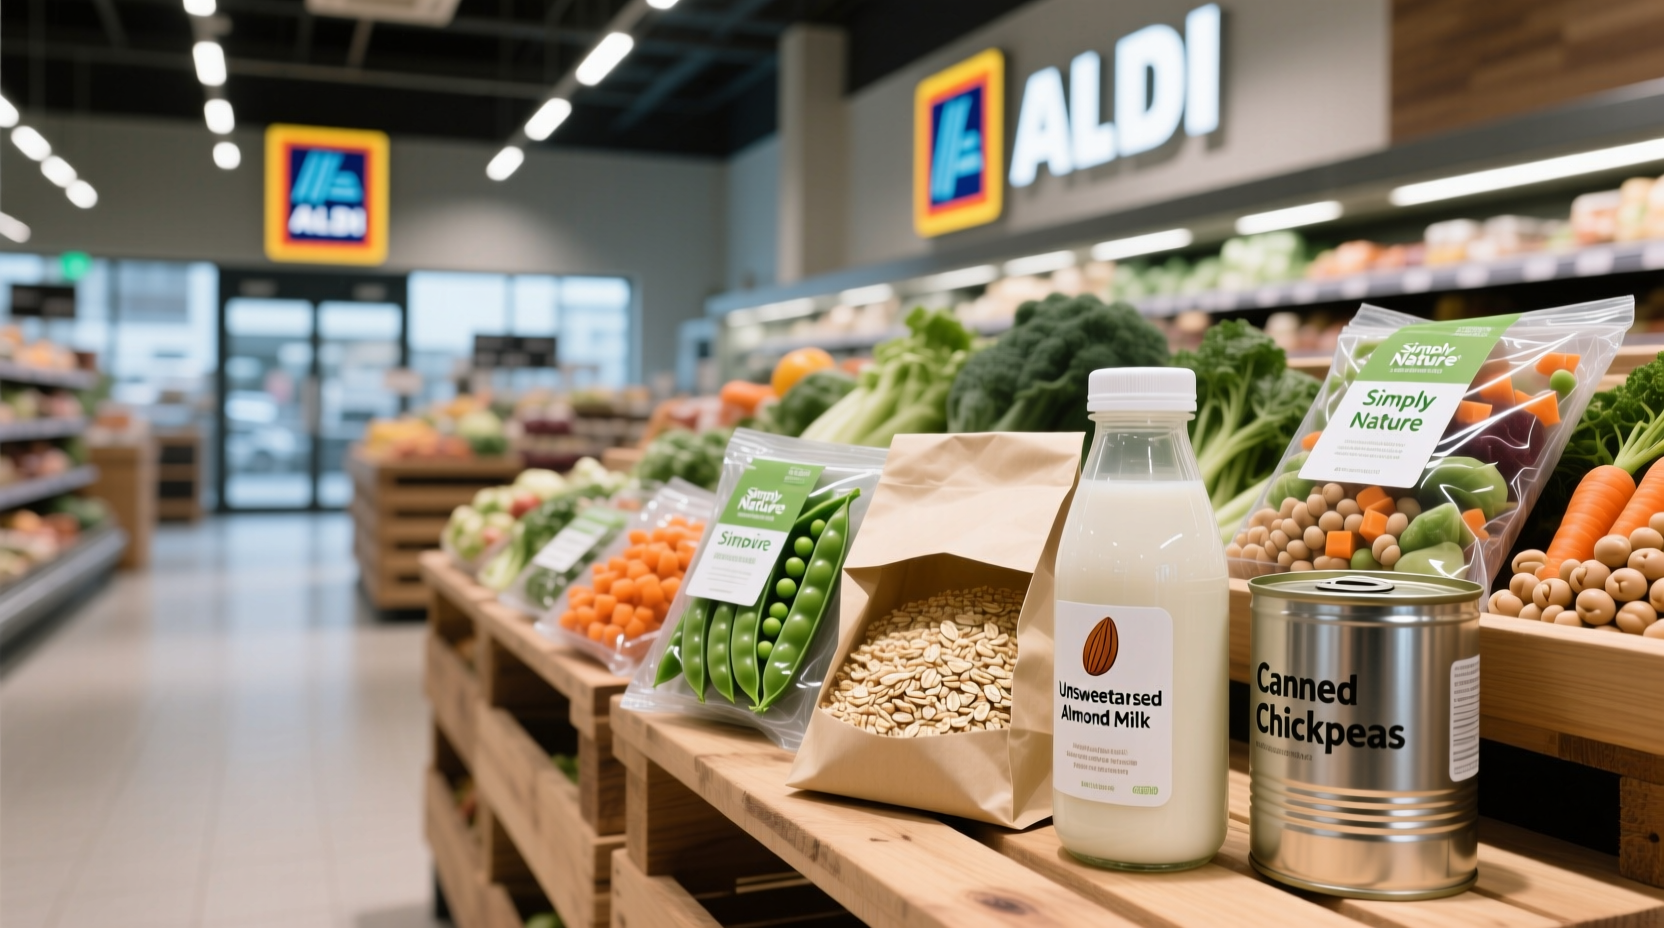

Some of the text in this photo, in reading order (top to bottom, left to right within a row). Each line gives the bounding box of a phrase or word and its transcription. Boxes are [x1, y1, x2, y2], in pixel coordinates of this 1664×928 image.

[1008, 2, 1221, 188] ALDI
[288, 203, 367, 238] ALDI
[1362, 388, 1437, 413] Simply
[1349, 411, 1423, 432] Nature
[1256, 661, 1358, 706] Canned
[1061, 704, 1151, 729] Almond Milk
[1256, 702, 1406, 755] Chickpeas
